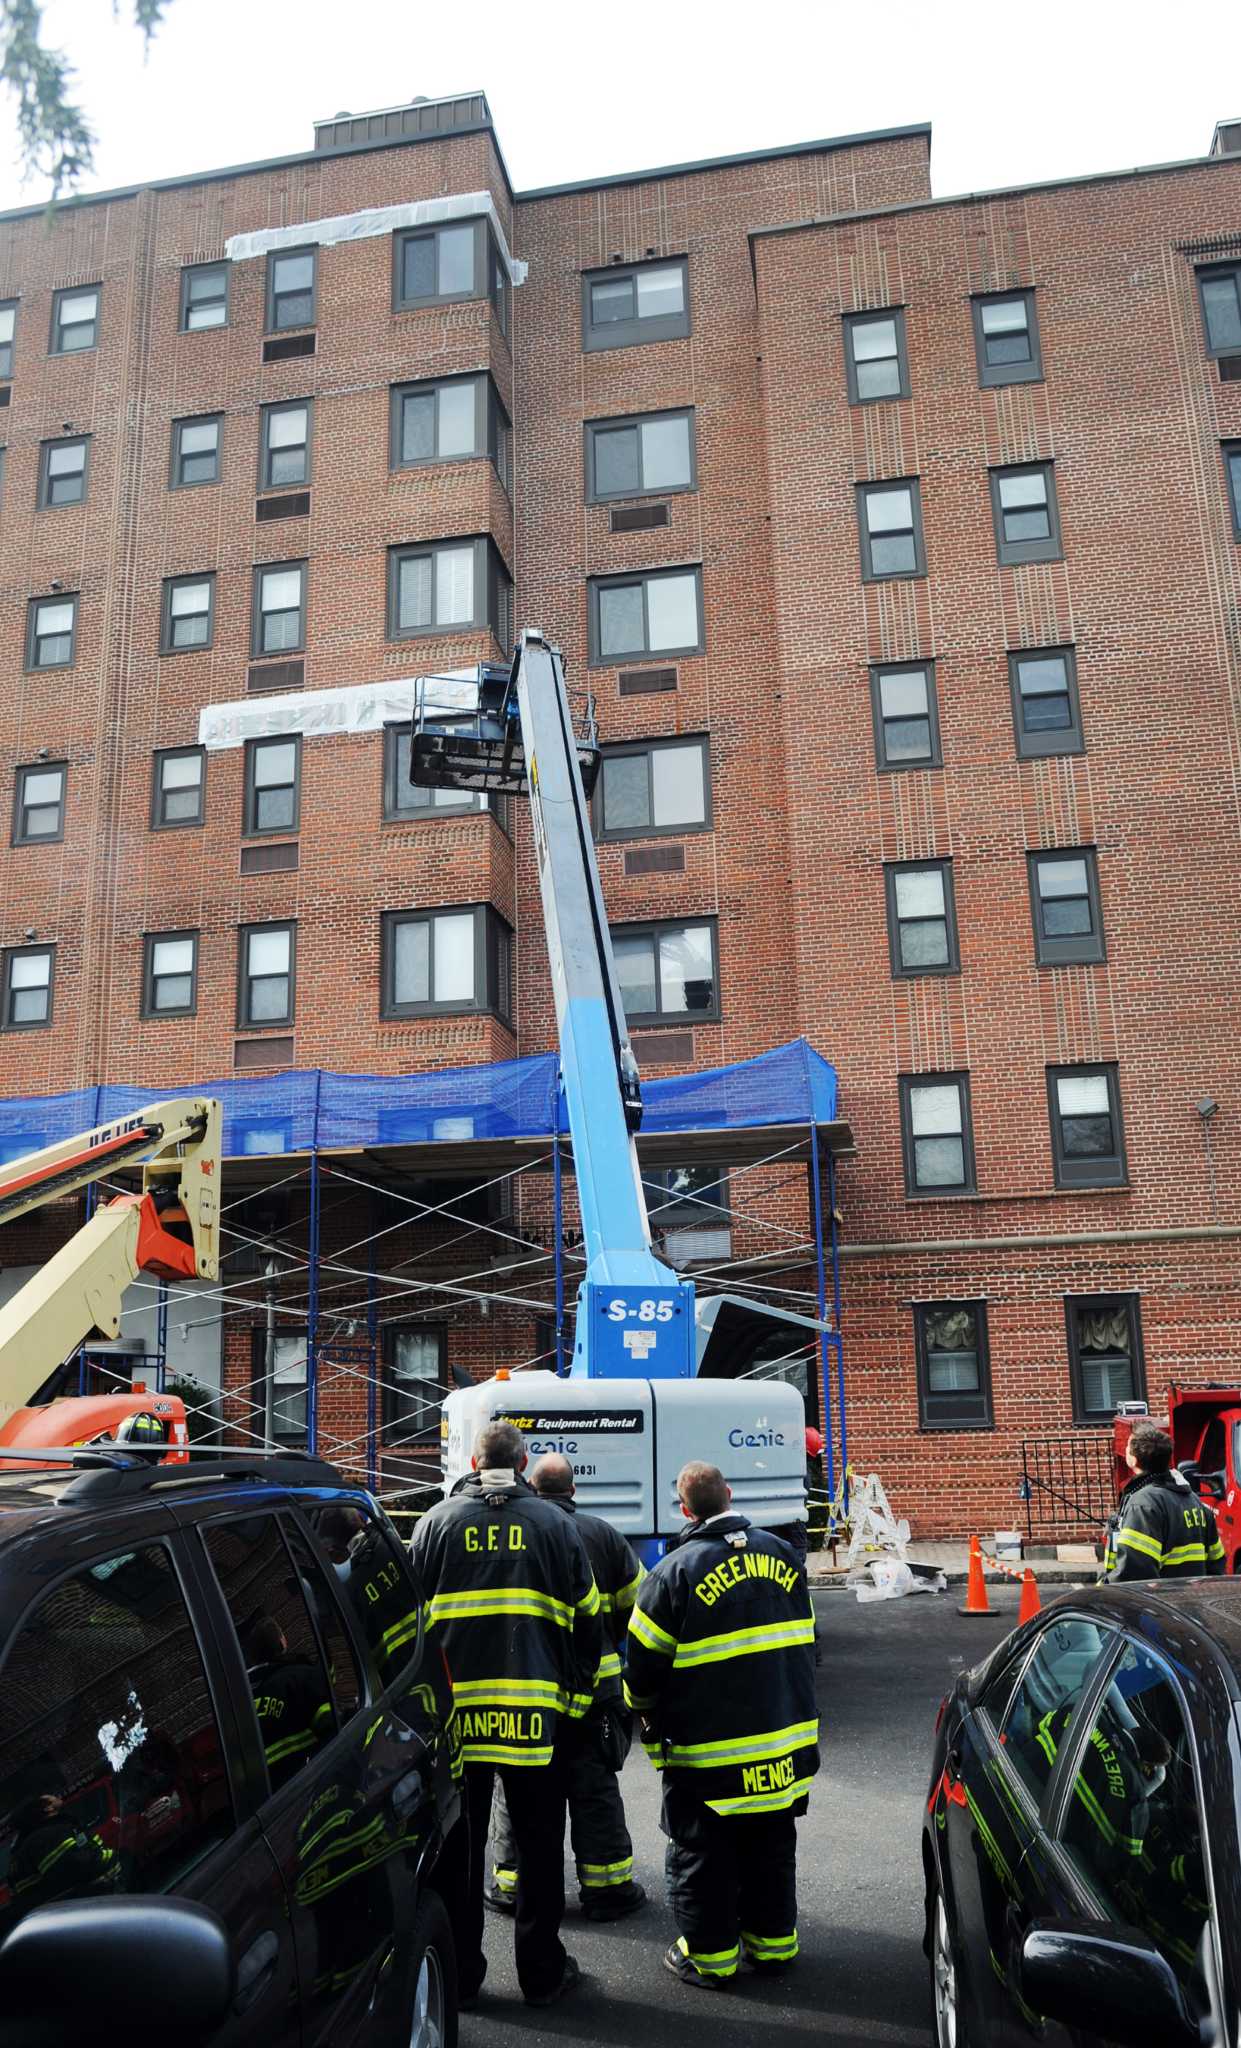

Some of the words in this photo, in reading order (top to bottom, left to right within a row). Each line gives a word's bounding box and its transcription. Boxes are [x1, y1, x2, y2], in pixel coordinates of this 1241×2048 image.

[608, 1299, 674, 1322] S-85
[536, 1418, 600, 1430] Equipment
[599, 1417, 637, 1429] Rental
[529, 1436, 579, 1455] enie
[728, 1428, 785, 1448] Genie
[695, 1552, 799, 1606] GREENWICH
